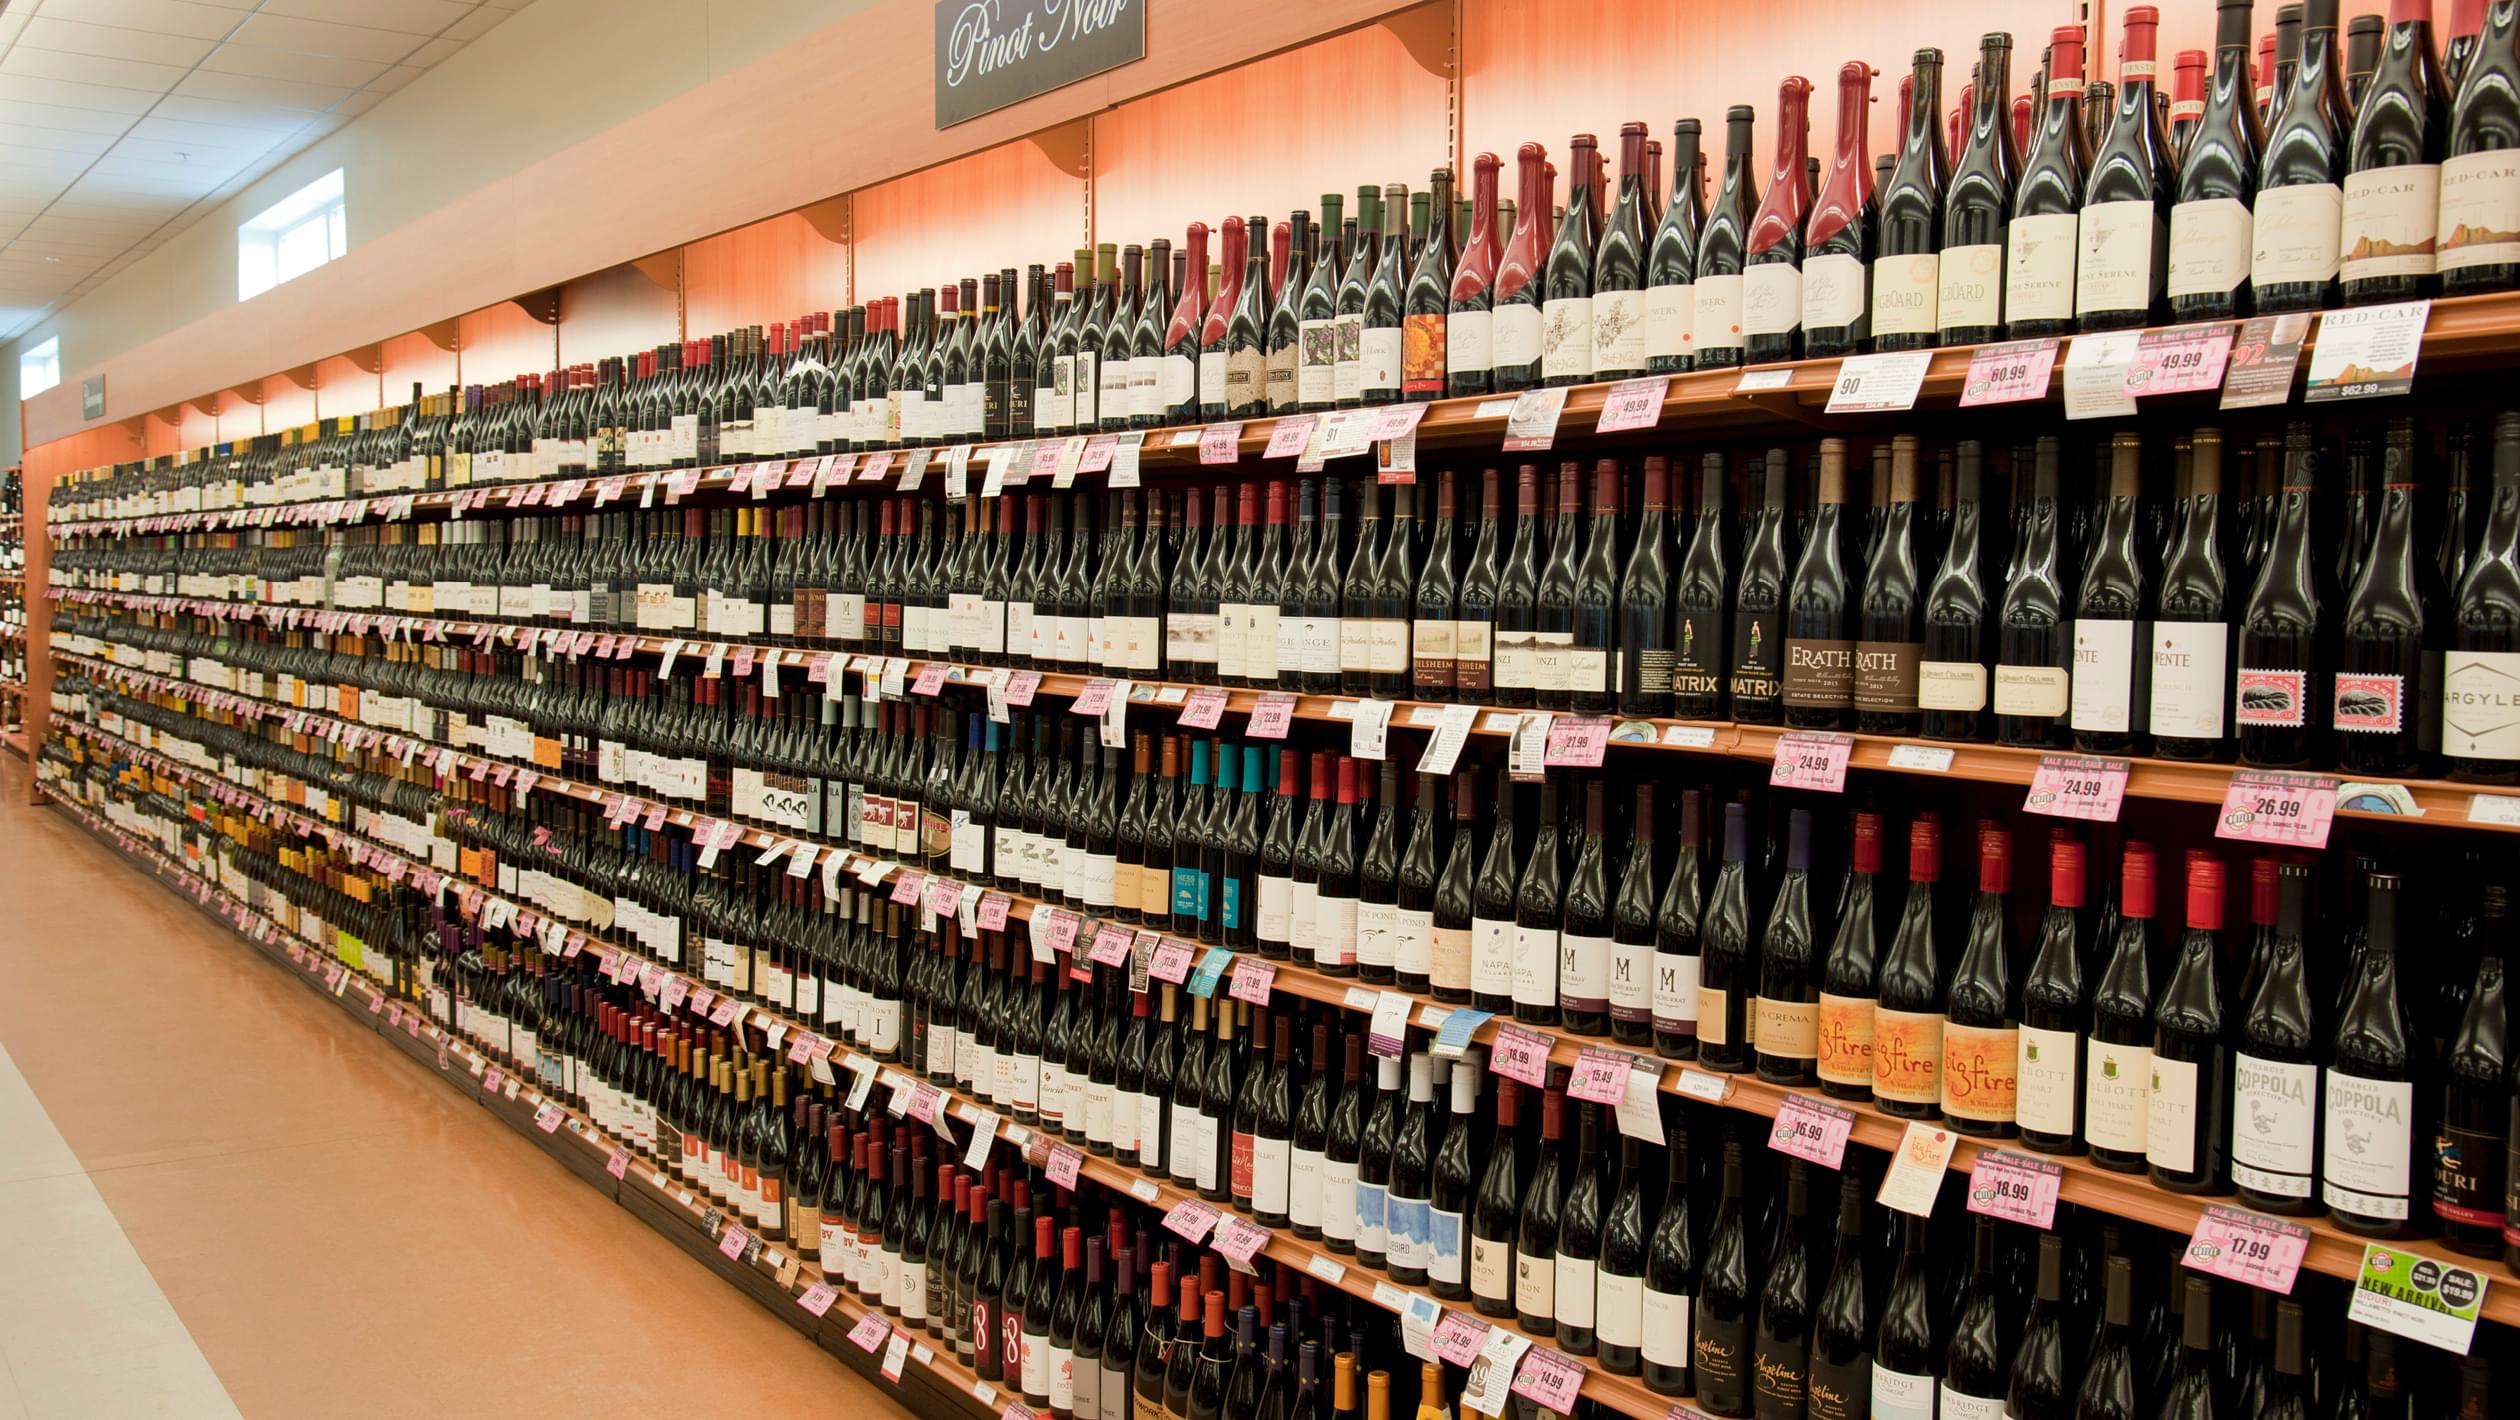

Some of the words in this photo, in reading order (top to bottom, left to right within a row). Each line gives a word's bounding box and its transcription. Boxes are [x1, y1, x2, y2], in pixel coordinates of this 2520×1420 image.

[947, 0, 1033, 87] Pinot
[1039, 0, 1128, 51] Noir
[2161, 352, 2202, 369] 49.99
[2232, 343, 2265, 367] 92
[1991, 365, 2026, 382] 60.99
[1840, 378, 1861, 395] 90
[2341, 384, 2378, 396] $62.99
[1623, 399, 1649, 412] 49.99
[1326, 428, 1338, 442] 91
[1791, 646, 1851, 669] ERATH
[1567, 736, 1588, 748] 27.99
[1799, 755, 1829, 771] 24.99
[2064, 780, 2102, 796] 24.99
[2255, 799, 2300, 817] 26.99
[1372, 912, 1397, 921] POND
[1482, 960, 1509, 969] NAPA
[1563, 947, 1576, 972] M
[1615, 957, 1631, 981] M
[1660, 967, 1676, 992] M
[1767, 1011, 1810, 1024] CREMA
[1509, 1048, 1529, 1065] 18.99
[1592, 1070, 1613, 1083] 15.49
[2237, 1067, 2305, 1105] COPPOLA
[2329, 1085, 2402, 1125] COPPOLA
[1796, 1121, 1823, 1141] 16.99
[1996, 1180, 2029, 1201] 18.99
[2361, 1276, 2393, 1296] NEW
[2442, 1284, 2474, 1301] $19.99
[2357, 1290, 2392, 1307] SIDURI
[1450, 1331, 1471, 1348] 13.99
[1470, 1362, 1489, 1386] 89
[1754, 1352, 1805, 1388] Angeline
[1541, 1371, 1564, 1390] 14.99
